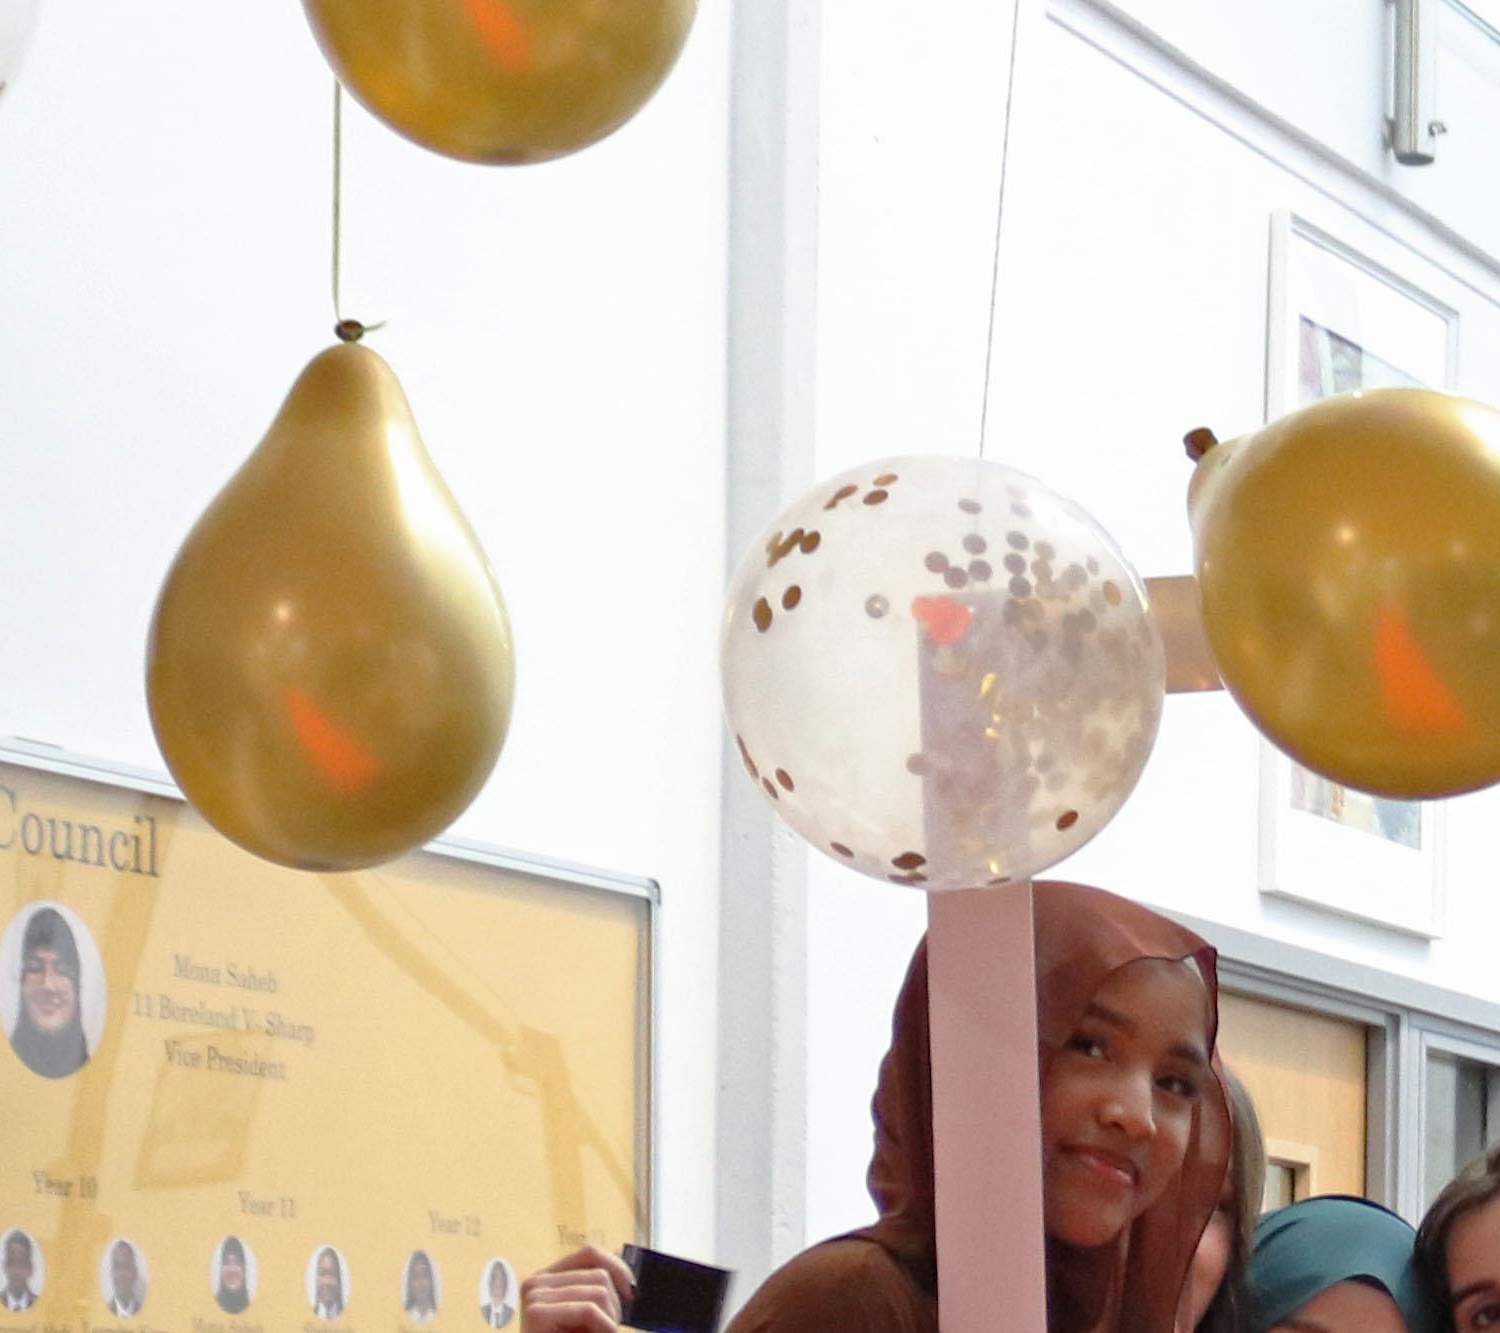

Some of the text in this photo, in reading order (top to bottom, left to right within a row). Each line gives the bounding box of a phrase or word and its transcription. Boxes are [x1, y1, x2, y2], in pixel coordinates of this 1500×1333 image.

[173, 953, 221, 985] Mona
[133, 992, 152, 1019] 11
[265, 1015, 317, 1047] Sharp
[164, 1040, 288, 1081] Vice President
[32, 1170, 99, 1200] Year 10
[237, 1191, 297, 1220] Year 11
[429, 1209, 465, 1235] Year
